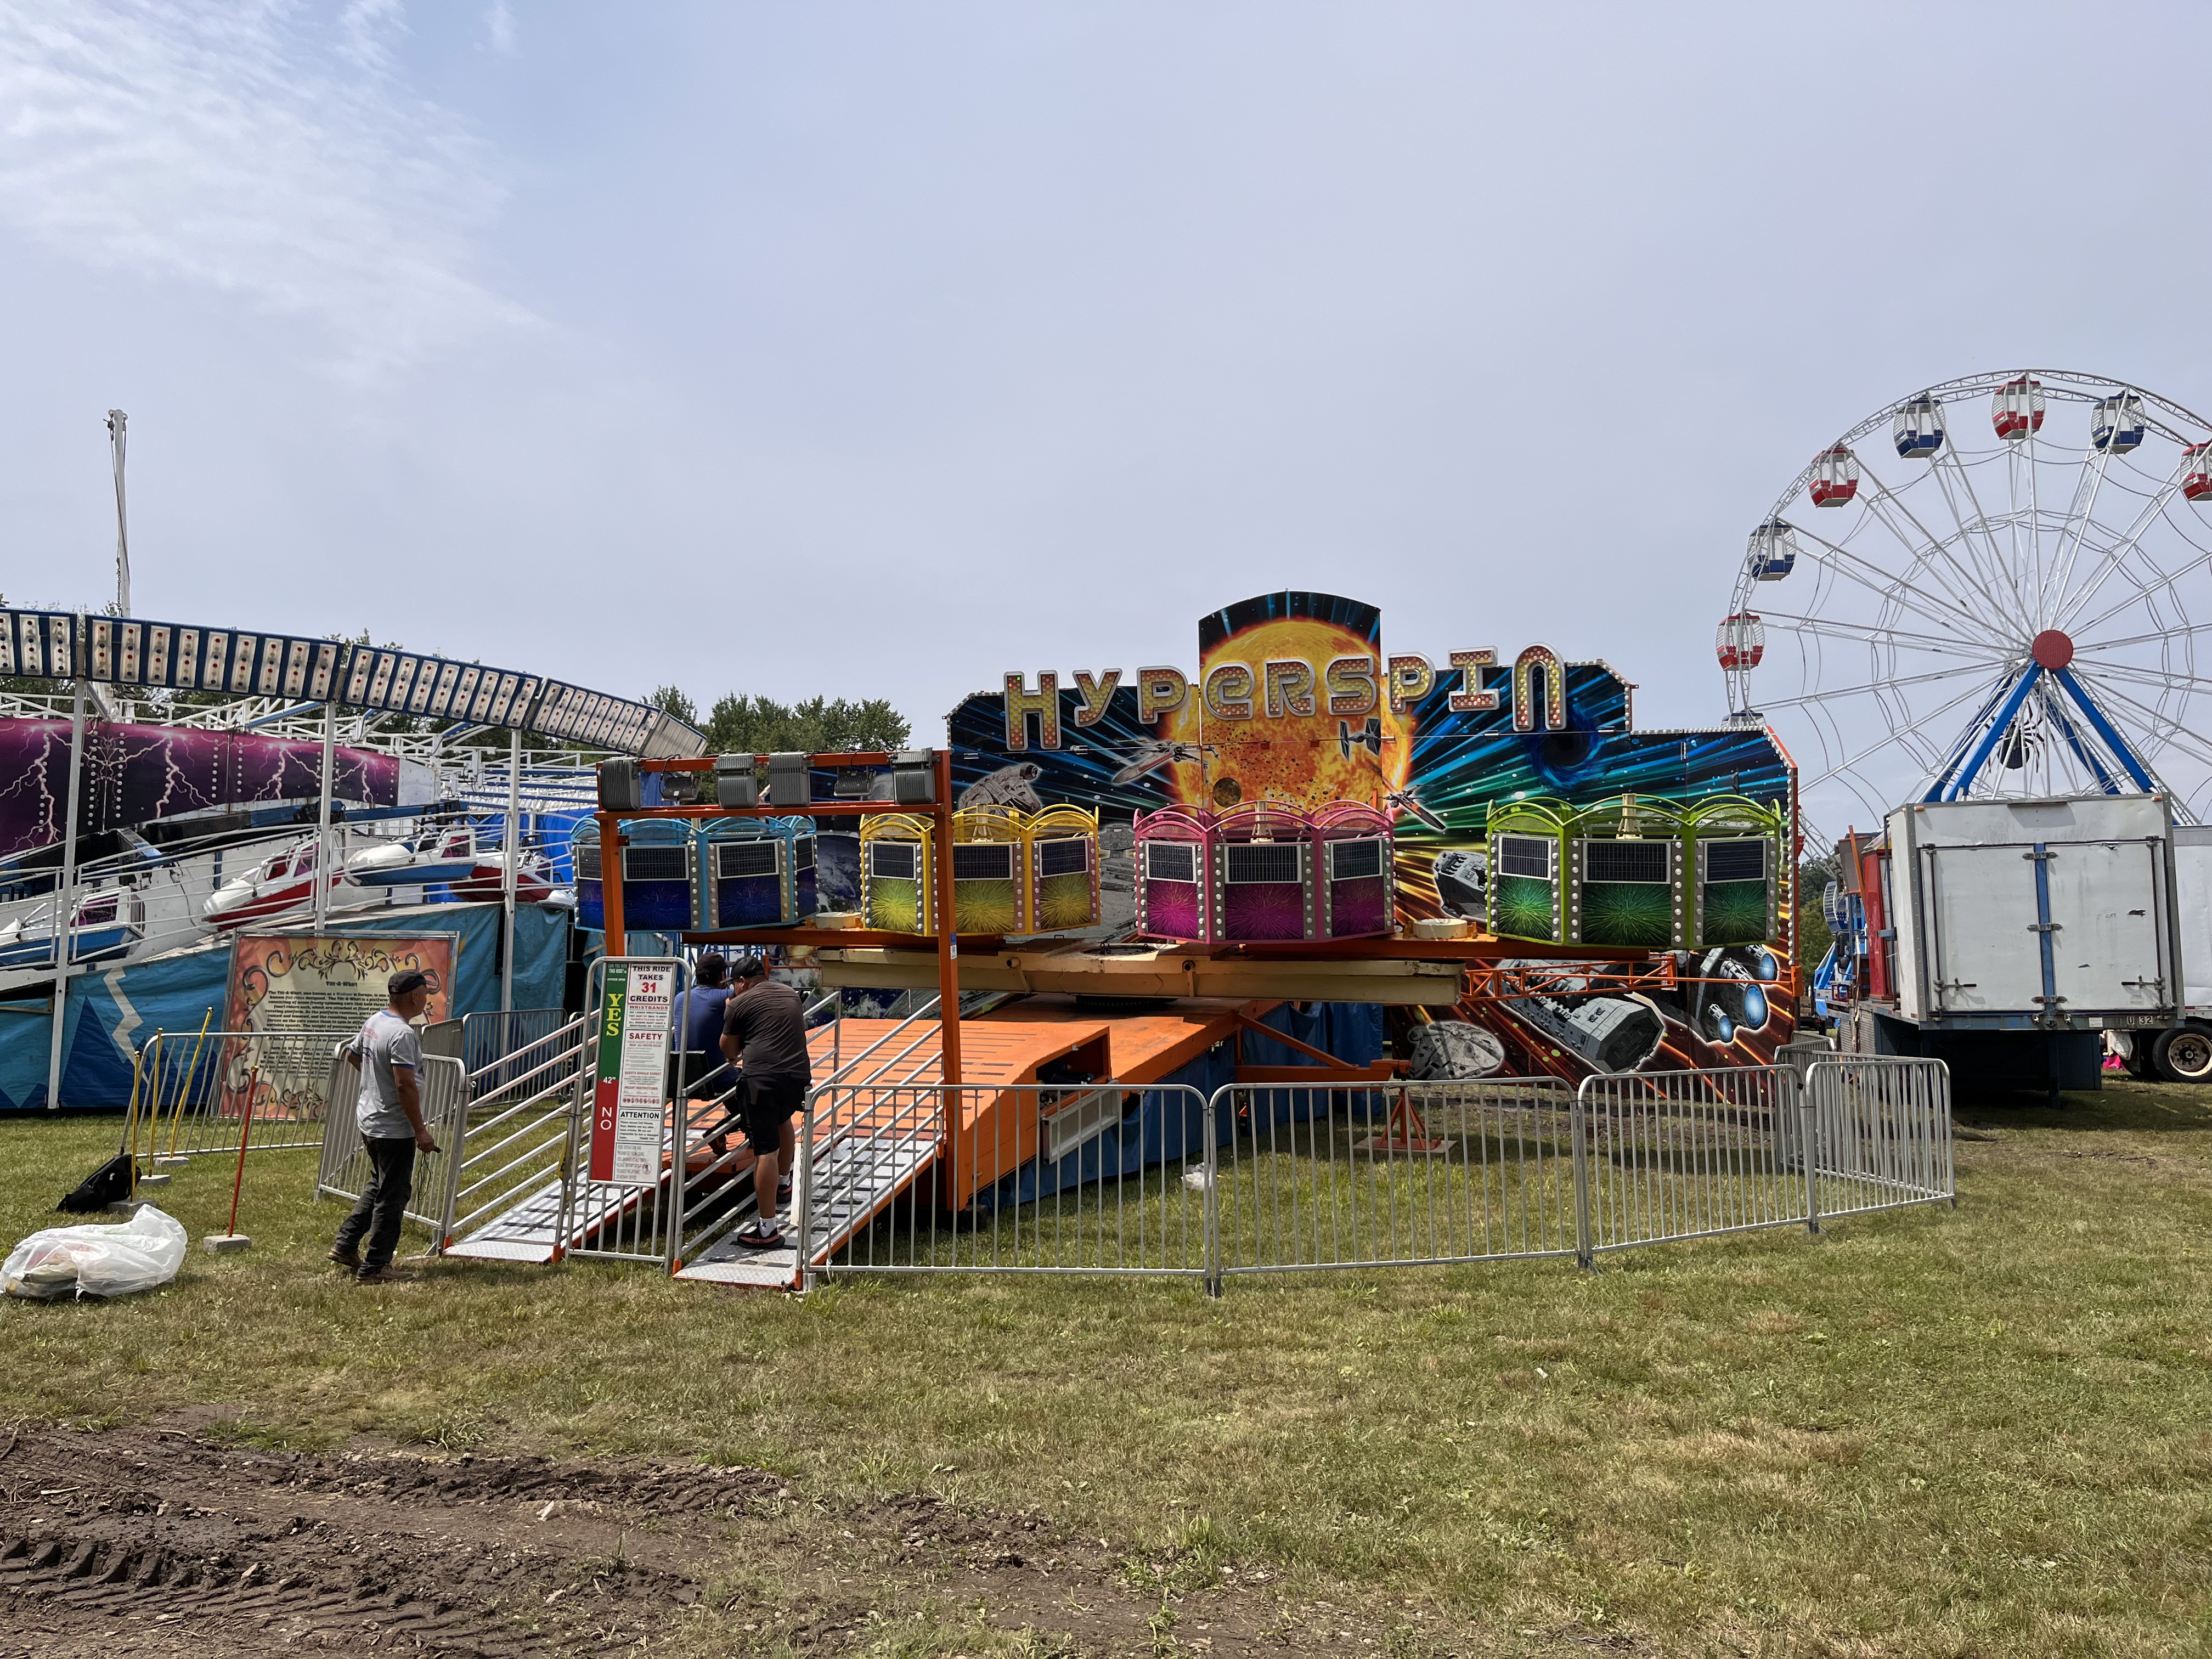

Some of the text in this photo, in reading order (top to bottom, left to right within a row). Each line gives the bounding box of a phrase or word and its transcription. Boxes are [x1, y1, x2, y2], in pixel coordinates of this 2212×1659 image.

[641, 982, 656, 993] 31
[606, 994, 624, 1036] YES
[600, 1106, 612, 1130] NO
